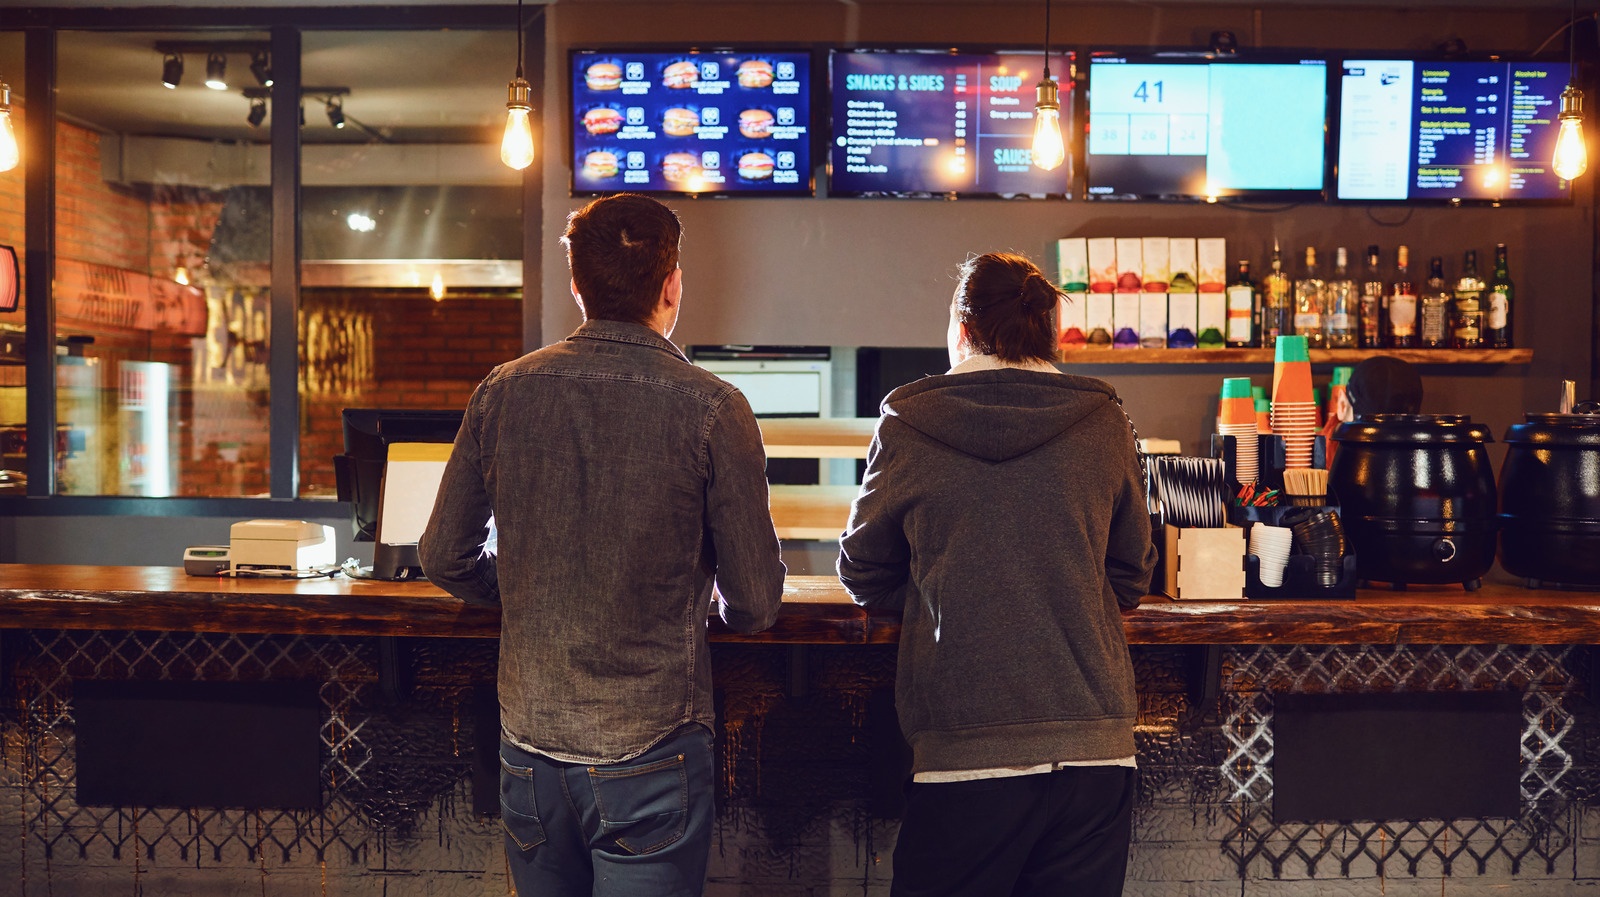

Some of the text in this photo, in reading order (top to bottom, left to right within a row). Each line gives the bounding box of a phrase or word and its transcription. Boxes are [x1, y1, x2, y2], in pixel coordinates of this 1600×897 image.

[847, 74, 895, 90] SNACKS
[898, 75, 908, 90] &
[909, 75, 944, 91] SIDES
[990, 76, 1021, 91] SOUP
[1133, 80, 1164, 103] 41
[990, 110, 1009, 119] Soup
[1101, 129, 1117, 140] 38
[1141, 129, 1157, 140] 26
[1180, 129, 1196, 141] 24
[994, 149, 1032, 164] SAUCE
